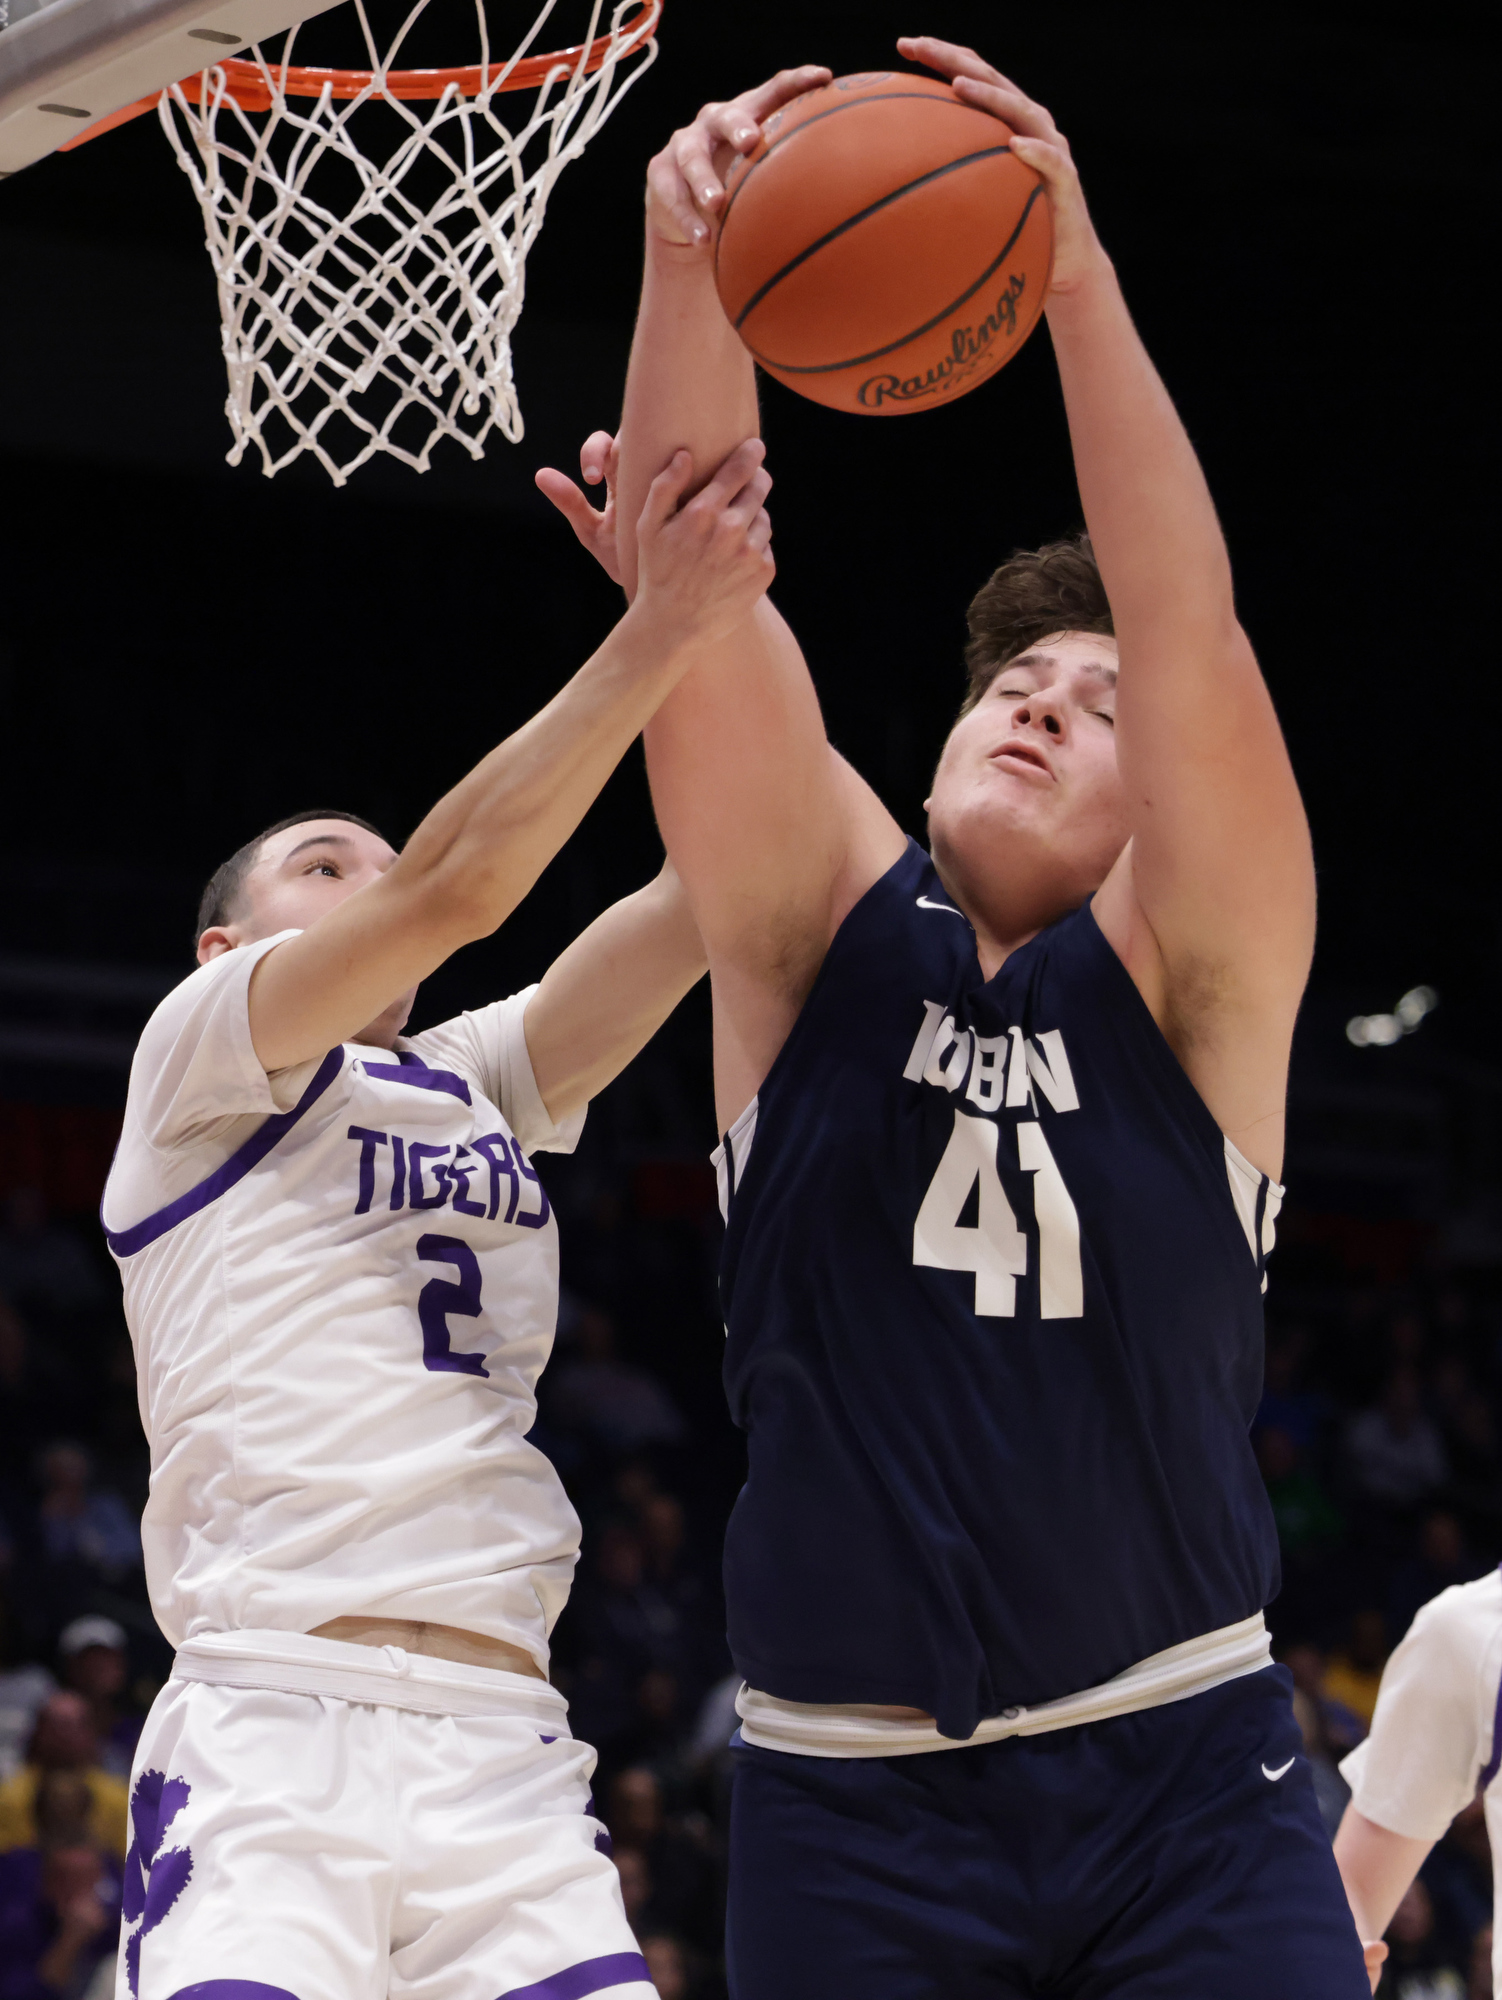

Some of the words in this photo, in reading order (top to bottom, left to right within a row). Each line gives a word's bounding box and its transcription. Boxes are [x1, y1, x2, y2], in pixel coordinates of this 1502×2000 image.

[857, 272, 1026, 407] Rawlings
[347, 1125, 550, 1229] TIGERS
[912, 1107, 1083, 1319] 41
[416, 1233, 490, 1378] 2
